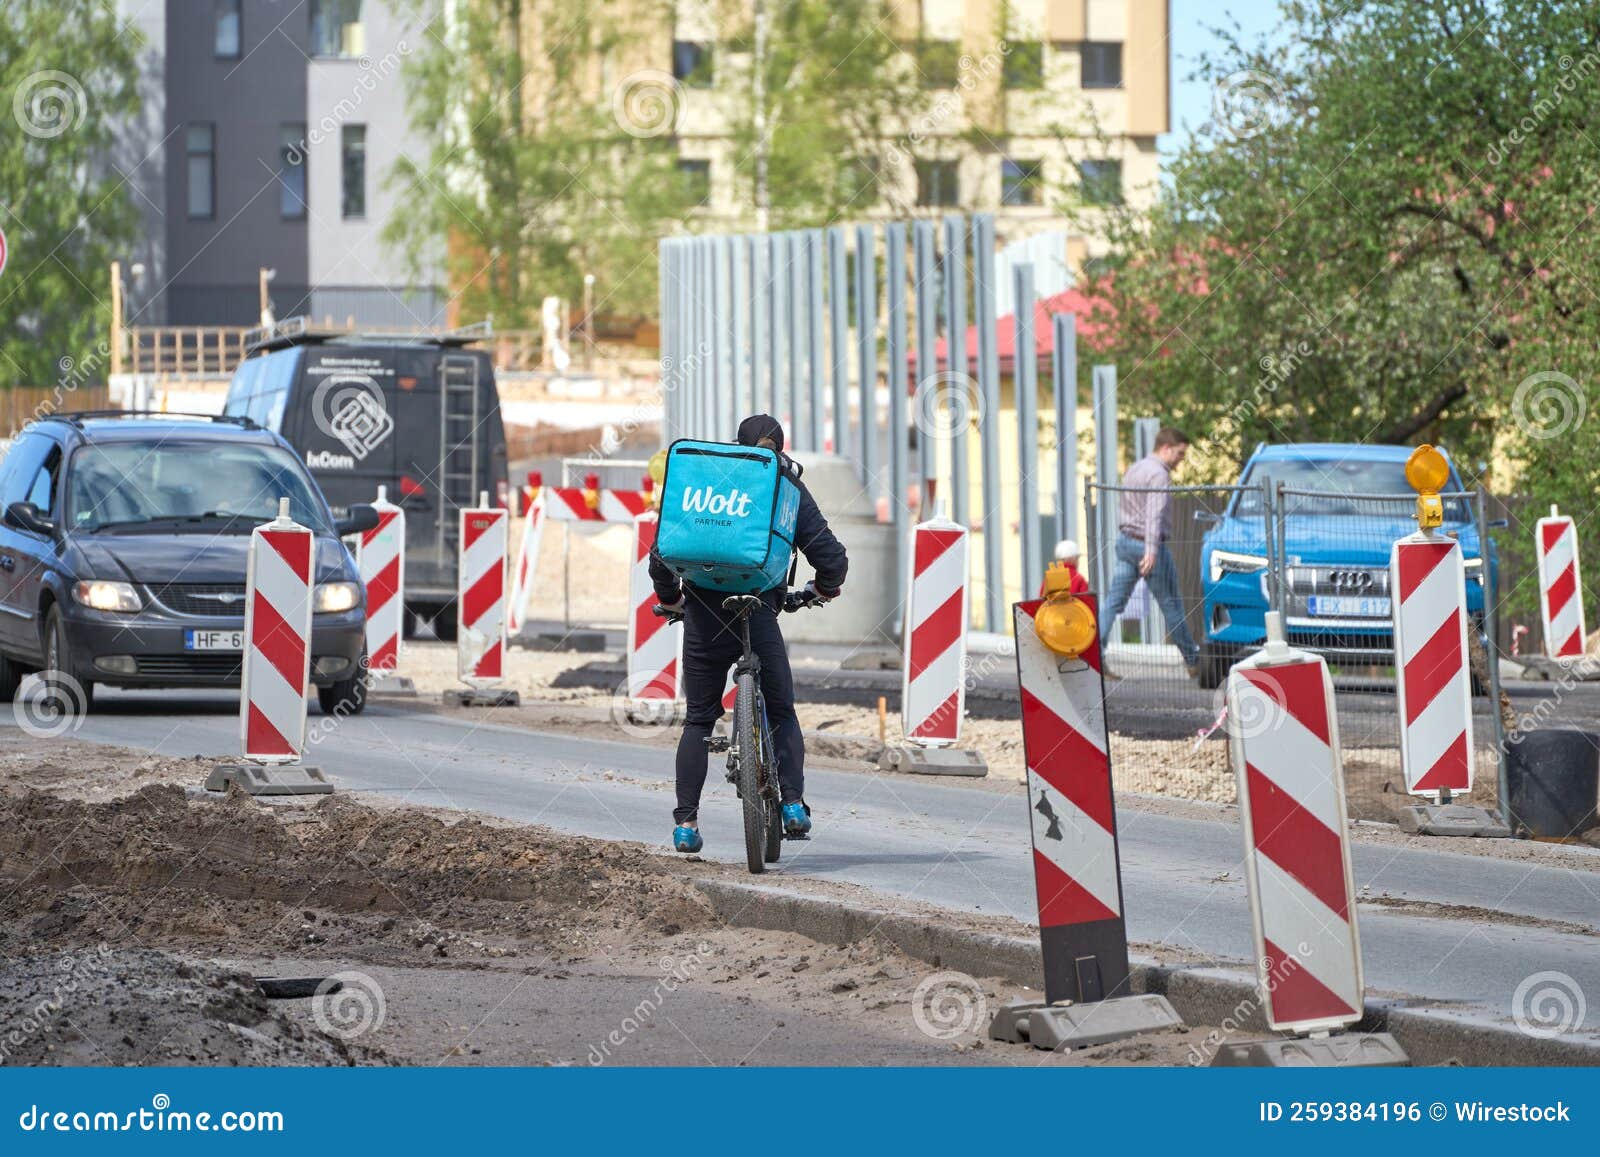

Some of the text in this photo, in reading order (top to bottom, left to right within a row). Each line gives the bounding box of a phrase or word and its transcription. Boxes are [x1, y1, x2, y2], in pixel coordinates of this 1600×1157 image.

[681, 486, 752, 518] Wolt
[694, 518, 732, 527] PARTNER
[197, 632, 244, 648] HF-6
